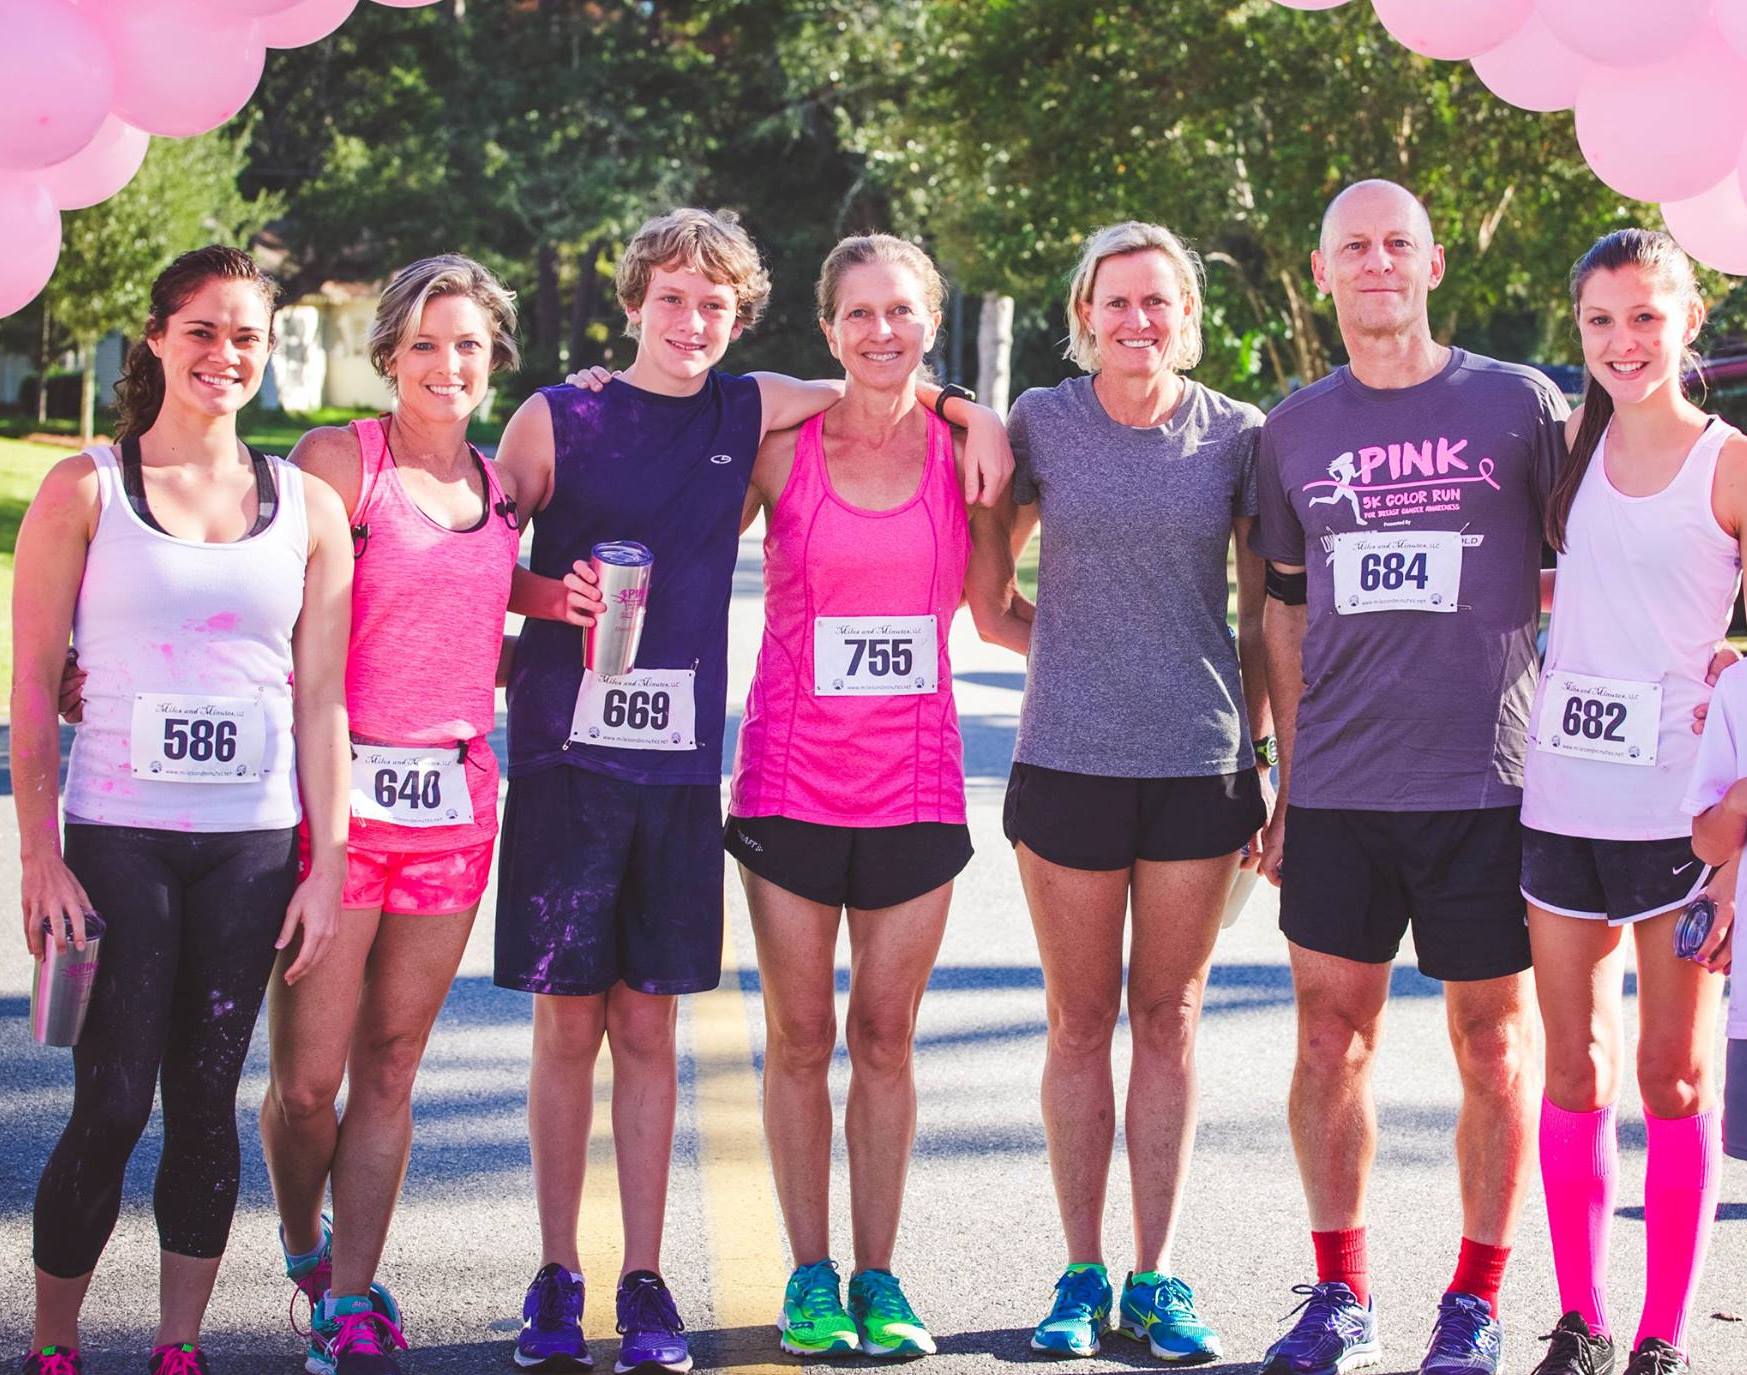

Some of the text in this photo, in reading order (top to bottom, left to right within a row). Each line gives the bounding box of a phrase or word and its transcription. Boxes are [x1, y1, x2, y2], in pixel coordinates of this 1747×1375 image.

[1358, 437, 1468, 484] PINK
[1363, 488, 1461, 509] 5K COLOR RUN
[1364, 511, 1376, 519] FOR
[1360, 553, 1428, 591] 684
[844, 639, 913, 676] 755
[183, 707, 199, 715] and
[603, 689, 670, 730] 669
[1563, 696, 1627, 742] 682
[164, 718, 237, 762] 586
[392, 757, 406, 765] and
[375, 769, 441, 808] 640
